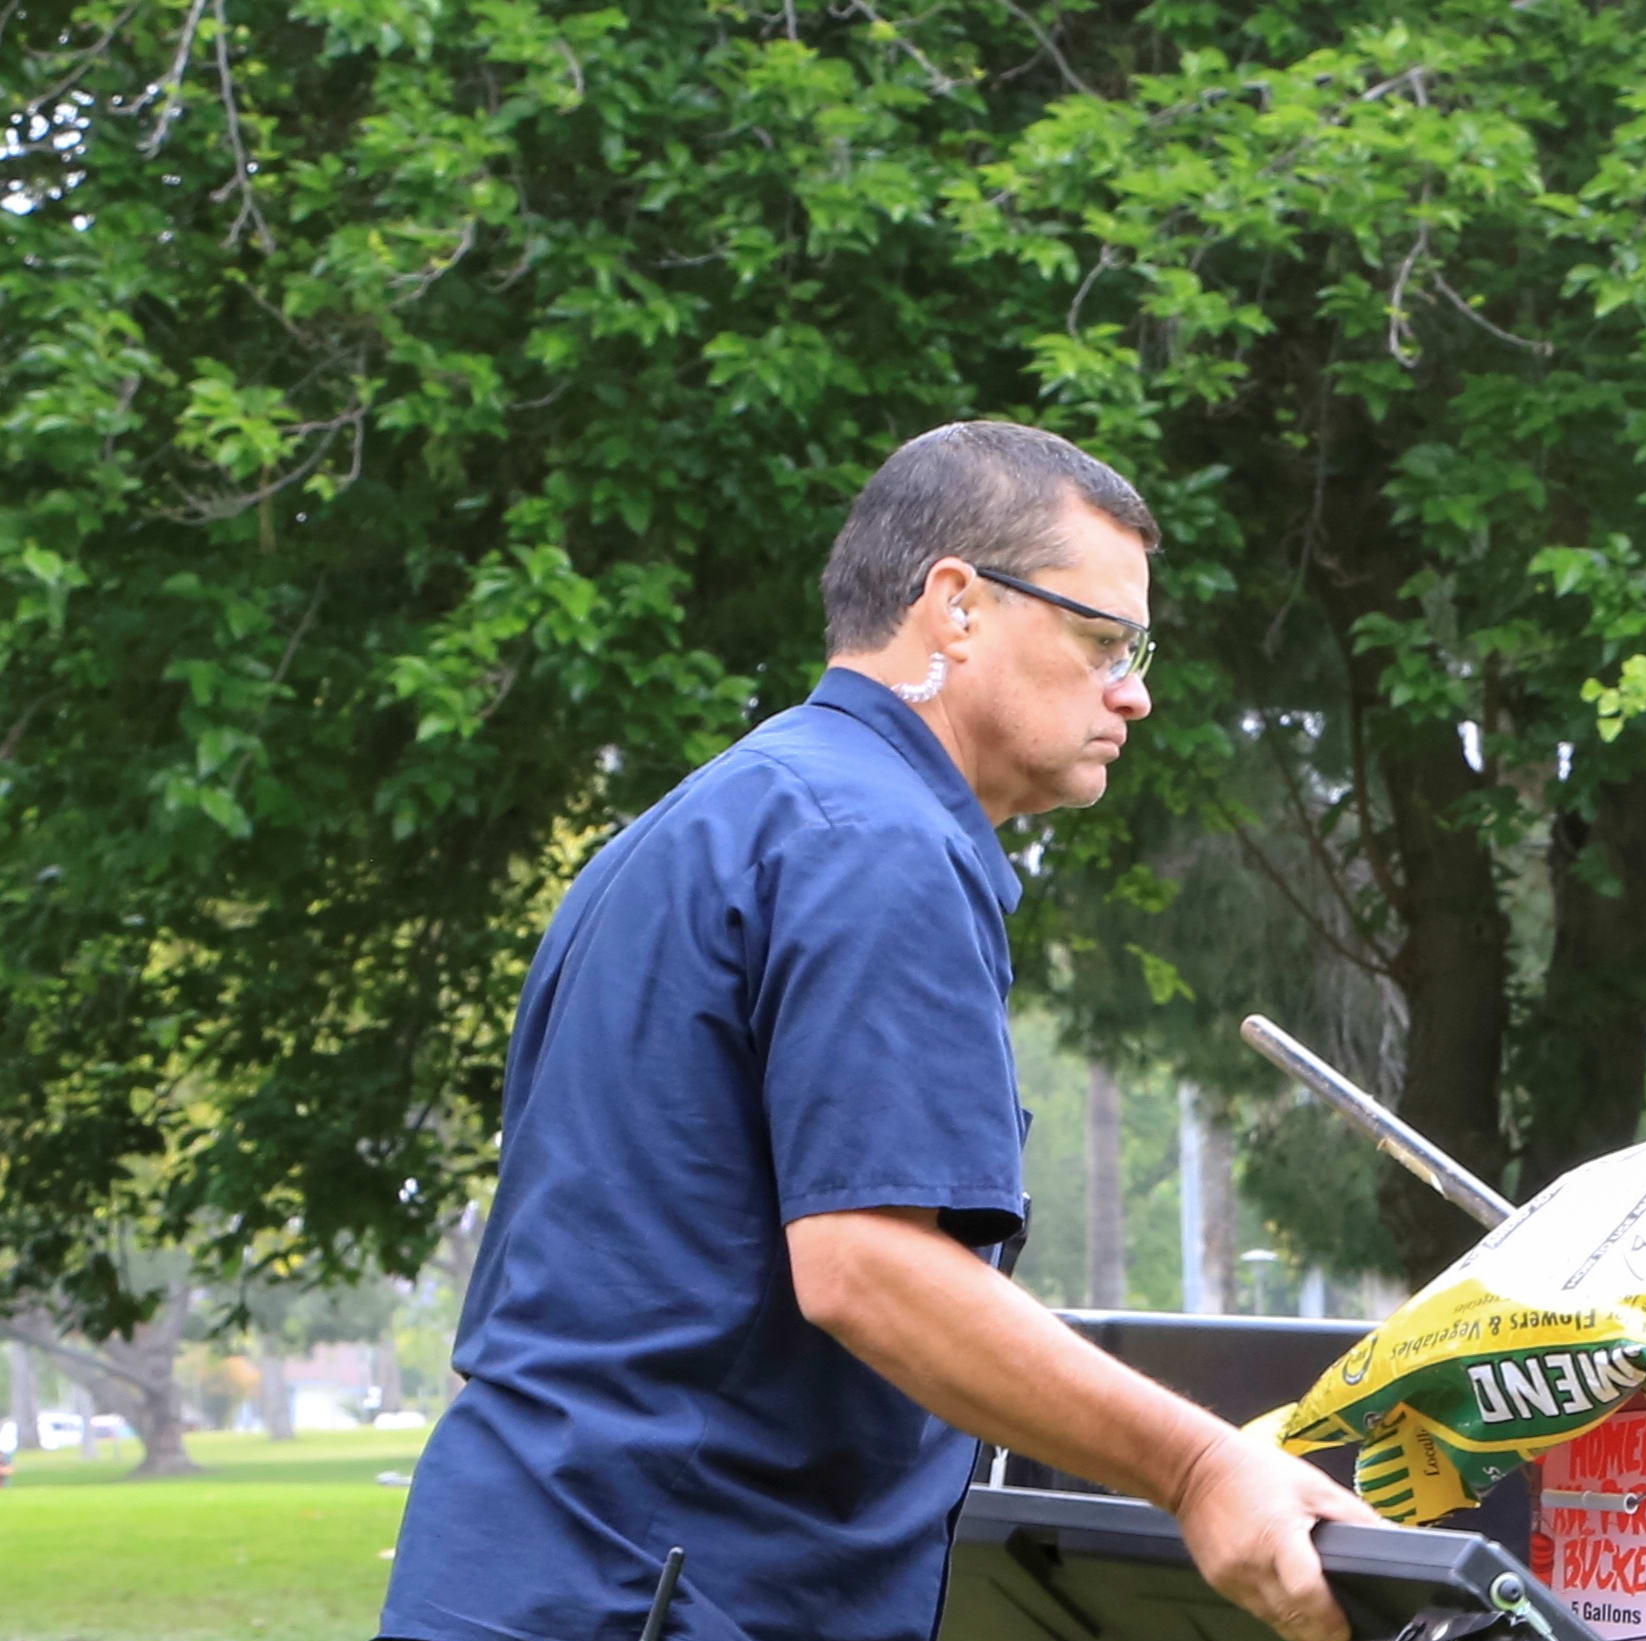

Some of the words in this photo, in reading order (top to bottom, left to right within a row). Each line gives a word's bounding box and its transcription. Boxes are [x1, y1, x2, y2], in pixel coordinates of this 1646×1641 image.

[1489, 1315, 1501, 1337] &
[1510, 1308, 1596, 1331] Flowers
[1390, 1318, 1481, 1360] Vegetables
[1416, 1428, 1440, 1476] Locall
[1583, 1602, 1641, 1624] Gallons
